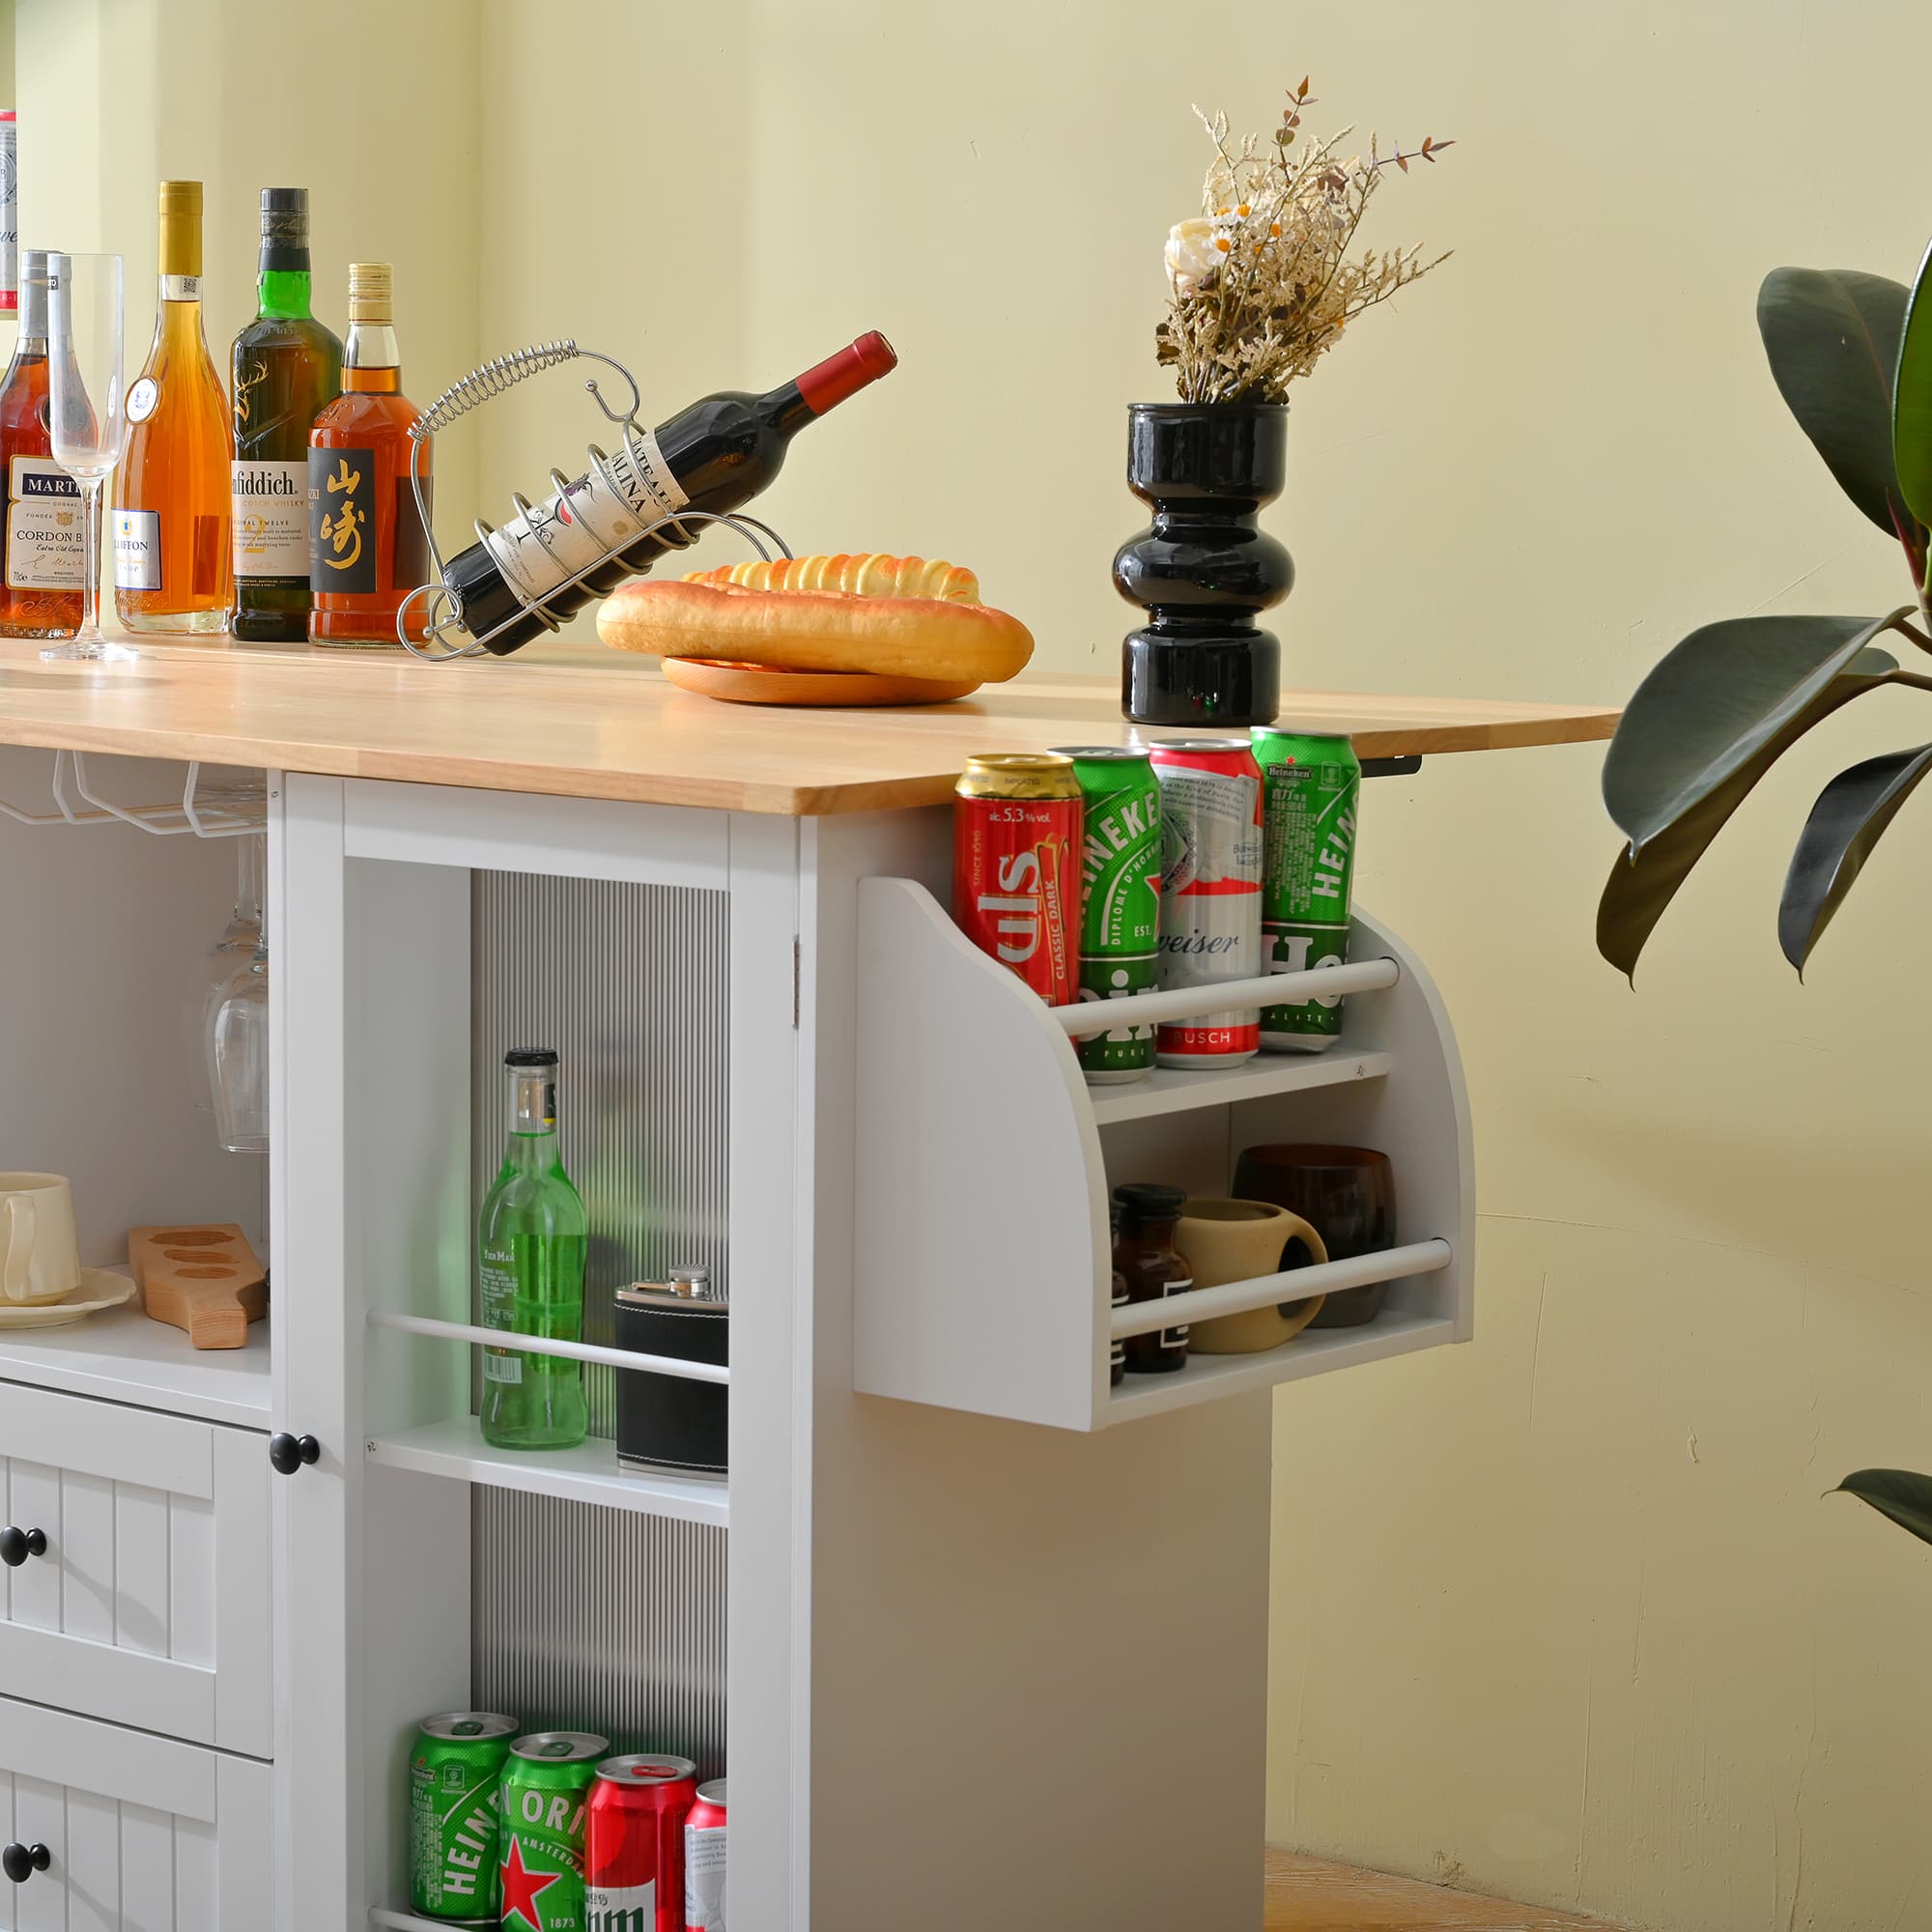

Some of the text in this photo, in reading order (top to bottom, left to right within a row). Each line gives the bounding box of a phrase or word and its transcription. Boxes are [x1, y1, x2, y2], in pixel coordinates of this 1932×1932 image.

[16, 529, 72, 542] CORDON
[1268, 767, 1310, 779] Heineken
[1003, 808, 1025, 822] 5.3
[1112, 888, 1128, 946] DIPLOME
[1045, 880, 1065, 980] CLASSIC DARK
[549, 1918, 576, 1929] 1873
